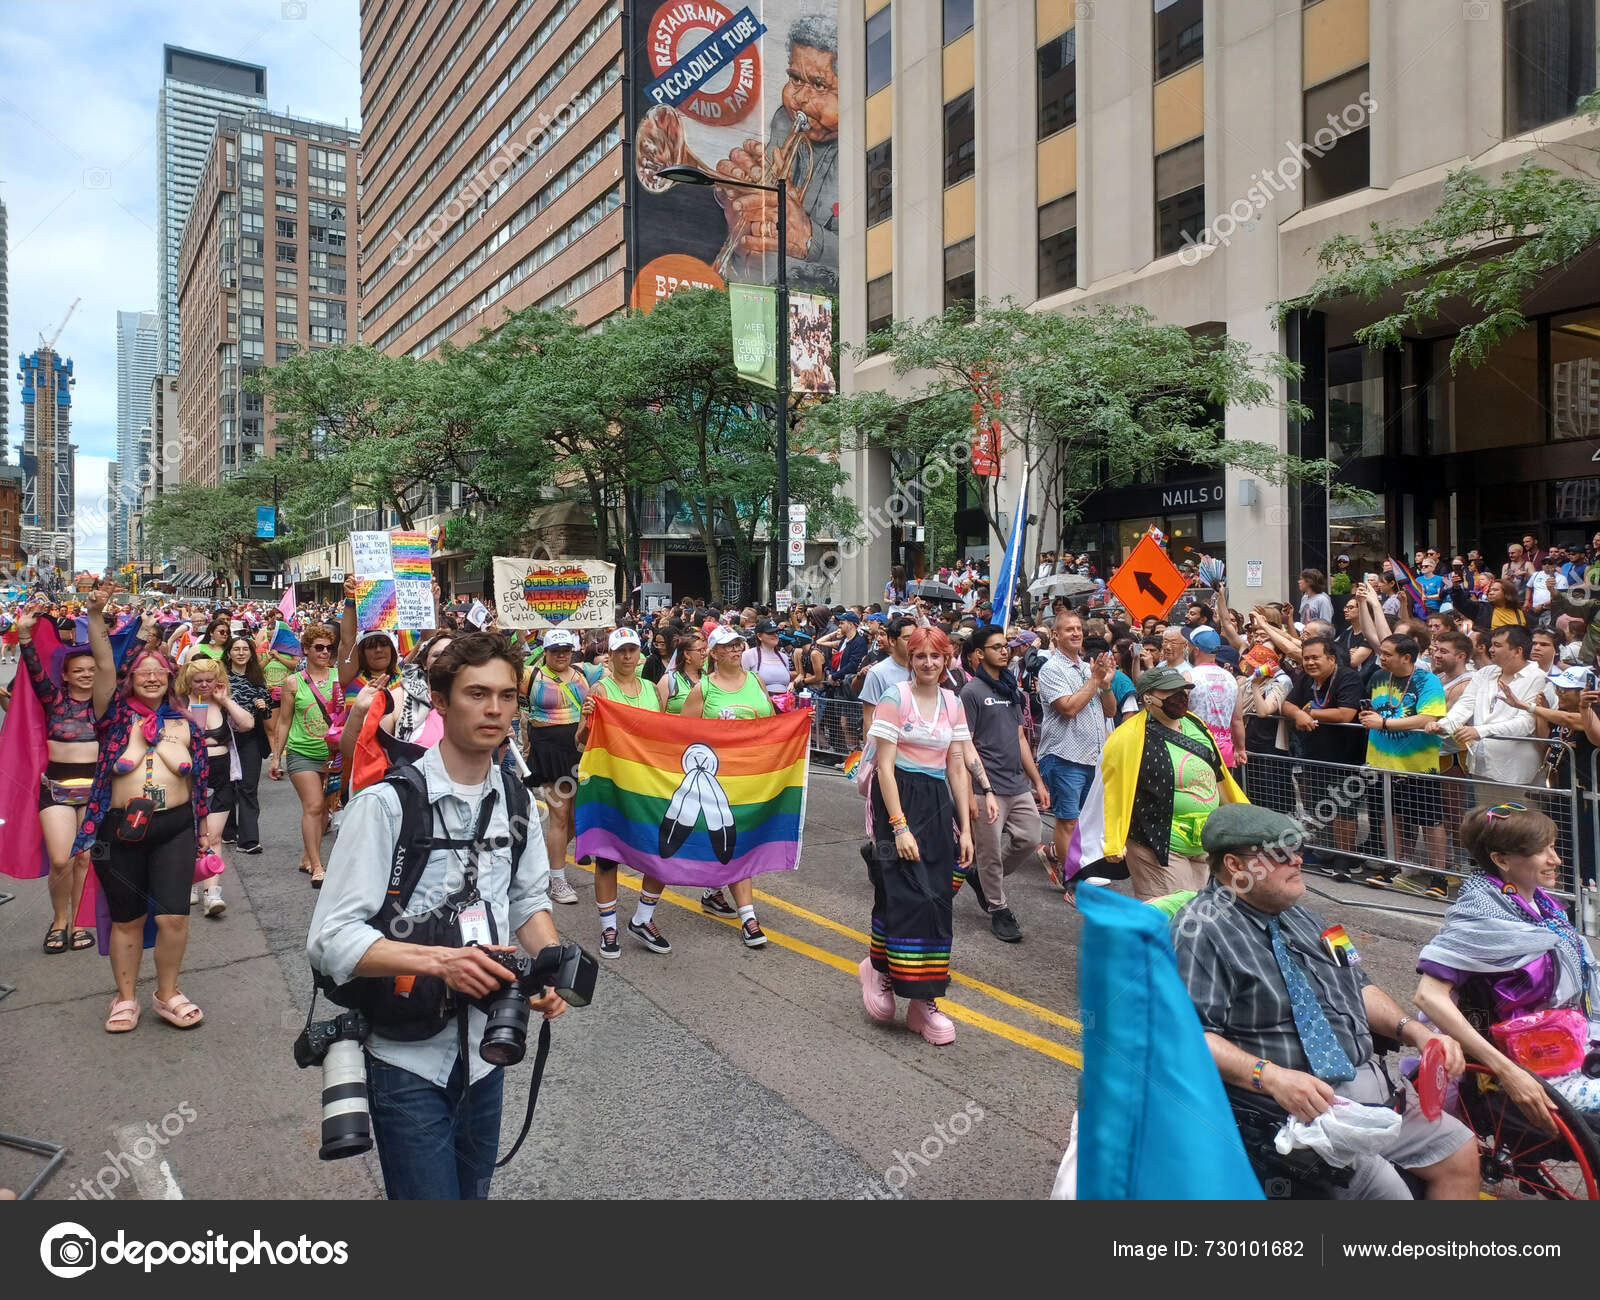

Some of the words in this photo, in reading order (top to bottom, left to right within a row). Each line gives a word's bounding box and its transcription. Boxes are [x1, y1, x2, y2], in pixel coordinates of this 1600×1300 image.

[655, 3, 725, 67] RESTAURANT
[651, 41, 723, 104] PICCADILLY
[721, 15, 757, 49] TUBE
[688, 98, 721, 118] AND
[724, 58, 754, 112] TAVERN
[1162, 487, 1209, 507] NAILS
[331, 572, 344, 580] 40
[548, 565, 582, 575] PEOPLE
[510, 578, 555, 590] SHOULD
[558, 577, 568, 587] BE
[571, 575, 608, 586] TREATED
[557, 589, 614, 600] REGARDLESS
[502, 603, 516, 613] OF
[520, 601, 546, 613] WHO
[550, 601, 574, 612] THEY
[576, 600, 594, 610] ARE
[596, 599, 608, 608] OR
[511, 612, 536, 622] WHO
[391, 845, 407, 887] SONY
